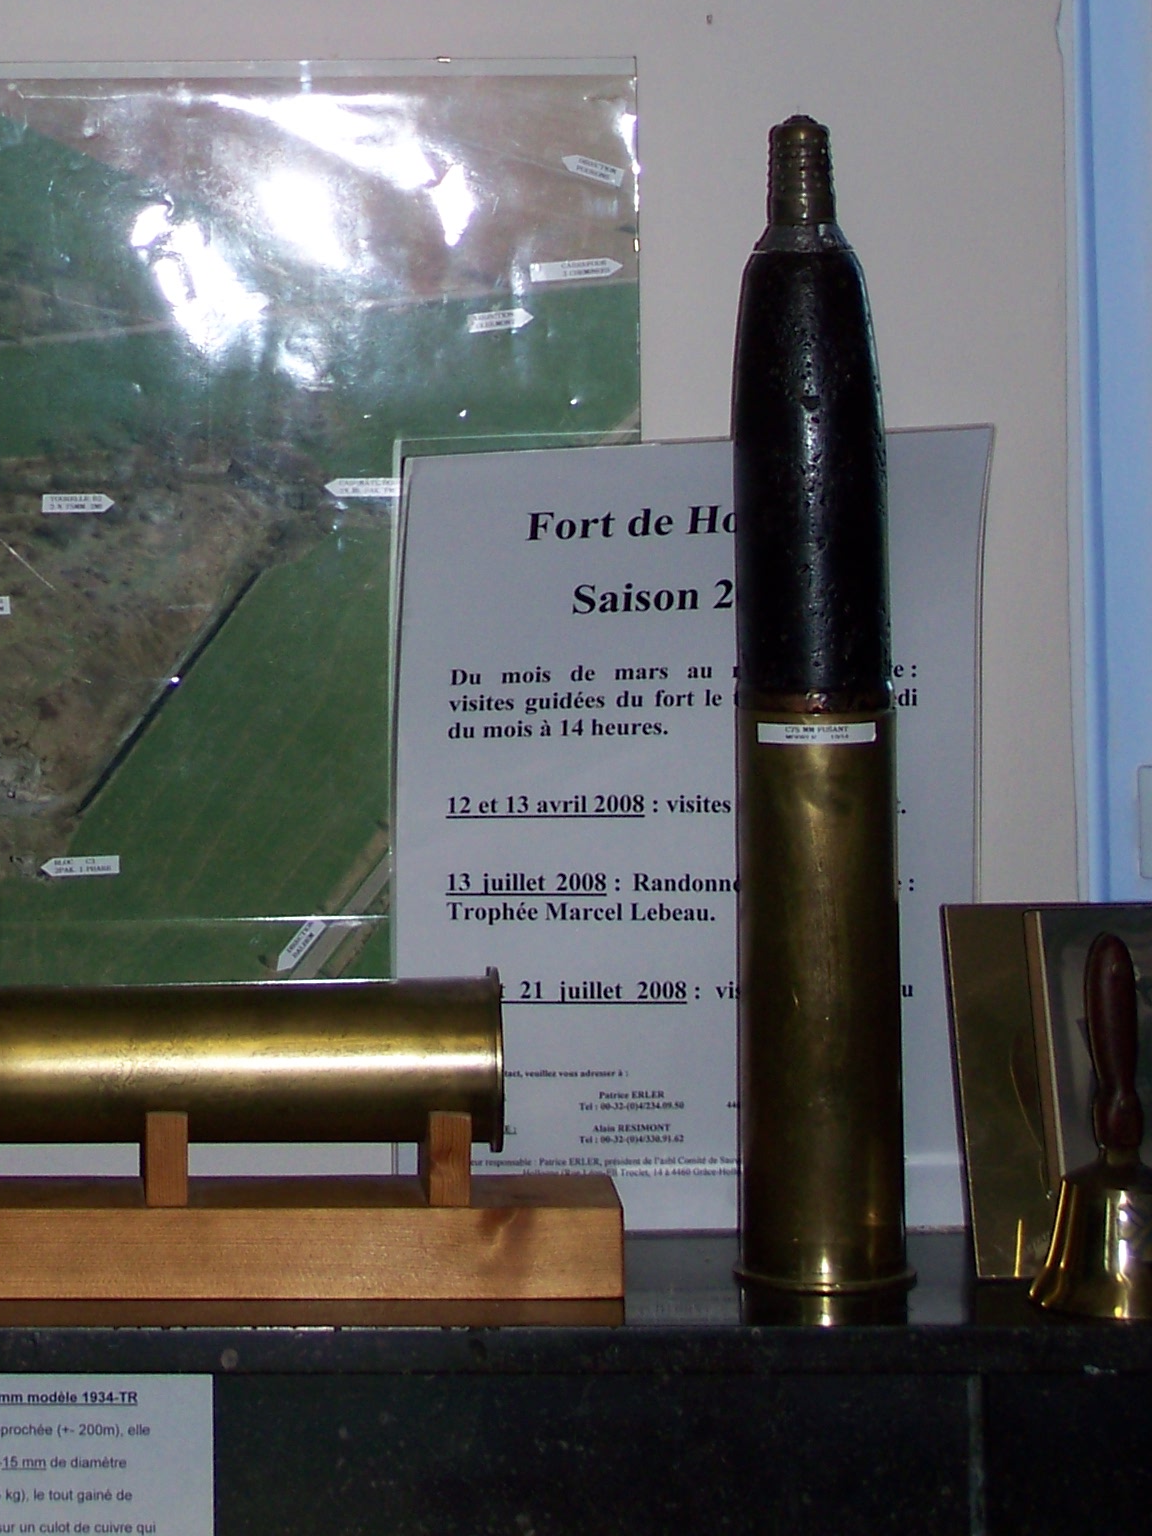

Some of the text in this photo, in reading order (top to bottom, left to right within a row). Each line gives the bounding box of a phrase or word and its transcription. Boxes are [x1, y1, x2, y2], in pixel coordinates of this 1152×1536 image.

[527, 510, 615, 541] Fort
[628, 507, 673, 537] de
[573, 582, 699, 615] Saison
[450, 668, 481, 686] Du
[501, 665, 552, 685] mois
[570, 664, 596, 683] de
[614, 667, 669, 682] mars
[687, 666, 713, 680] au
[448, 693, 515, 713] visites
[524, 690, 606, 715] guidées
[615, 689, 644, 709] du
[655, 688, 695, 708] fort
[705, 687, 723, 708] le
[447, 717, 669, 740] du mois à 14 heures.
[447, 793, 732, 816] 12 et 13 avril 2008 visites
[448, 872, 471, 892] 13
[483, 872, 546, 892] juillet
[555, 872, 607, 892] 2008
[445, 901, 716, 925] Trophée Marcel Lebeau.
[520, 980, 543, 999] 21
[560, 980, 623, 999] juillet
[636, 980, 687, 999] 2008
[598, 1090, 665, 1100] Patrice ERLER
[592, 1124, 616, 1133] Alain
[26, 1390, 78, 1403] modèle
[81, 1390, 138, 1403] 1934-TR
[56, 1423, 75, 1439] (+-
[78, 1423, 124, 1439] 200m),
[127, 1423, 151, 1437] elle
[21, 1458, 47, 1469] mm
[49, 1455, 67, 1469] de
[69, 1455, 127, 1469] diamètre
[5, 1488, 29, 1504] kg),
[33, 1487, 46, 1502] le
[48, 1489, 74, 1502] tout
[76, 1488, 113, 1505] gainé
[115, 1488, 133, 1502] de
[19, 1523, 36, 1534] un
[38, 1520, 71, 1534] culot
[73, 1521, 91, 1535] de
[93, 1521, 133, 1534] cuivre
[136, 1521, 157, 1536] qui
